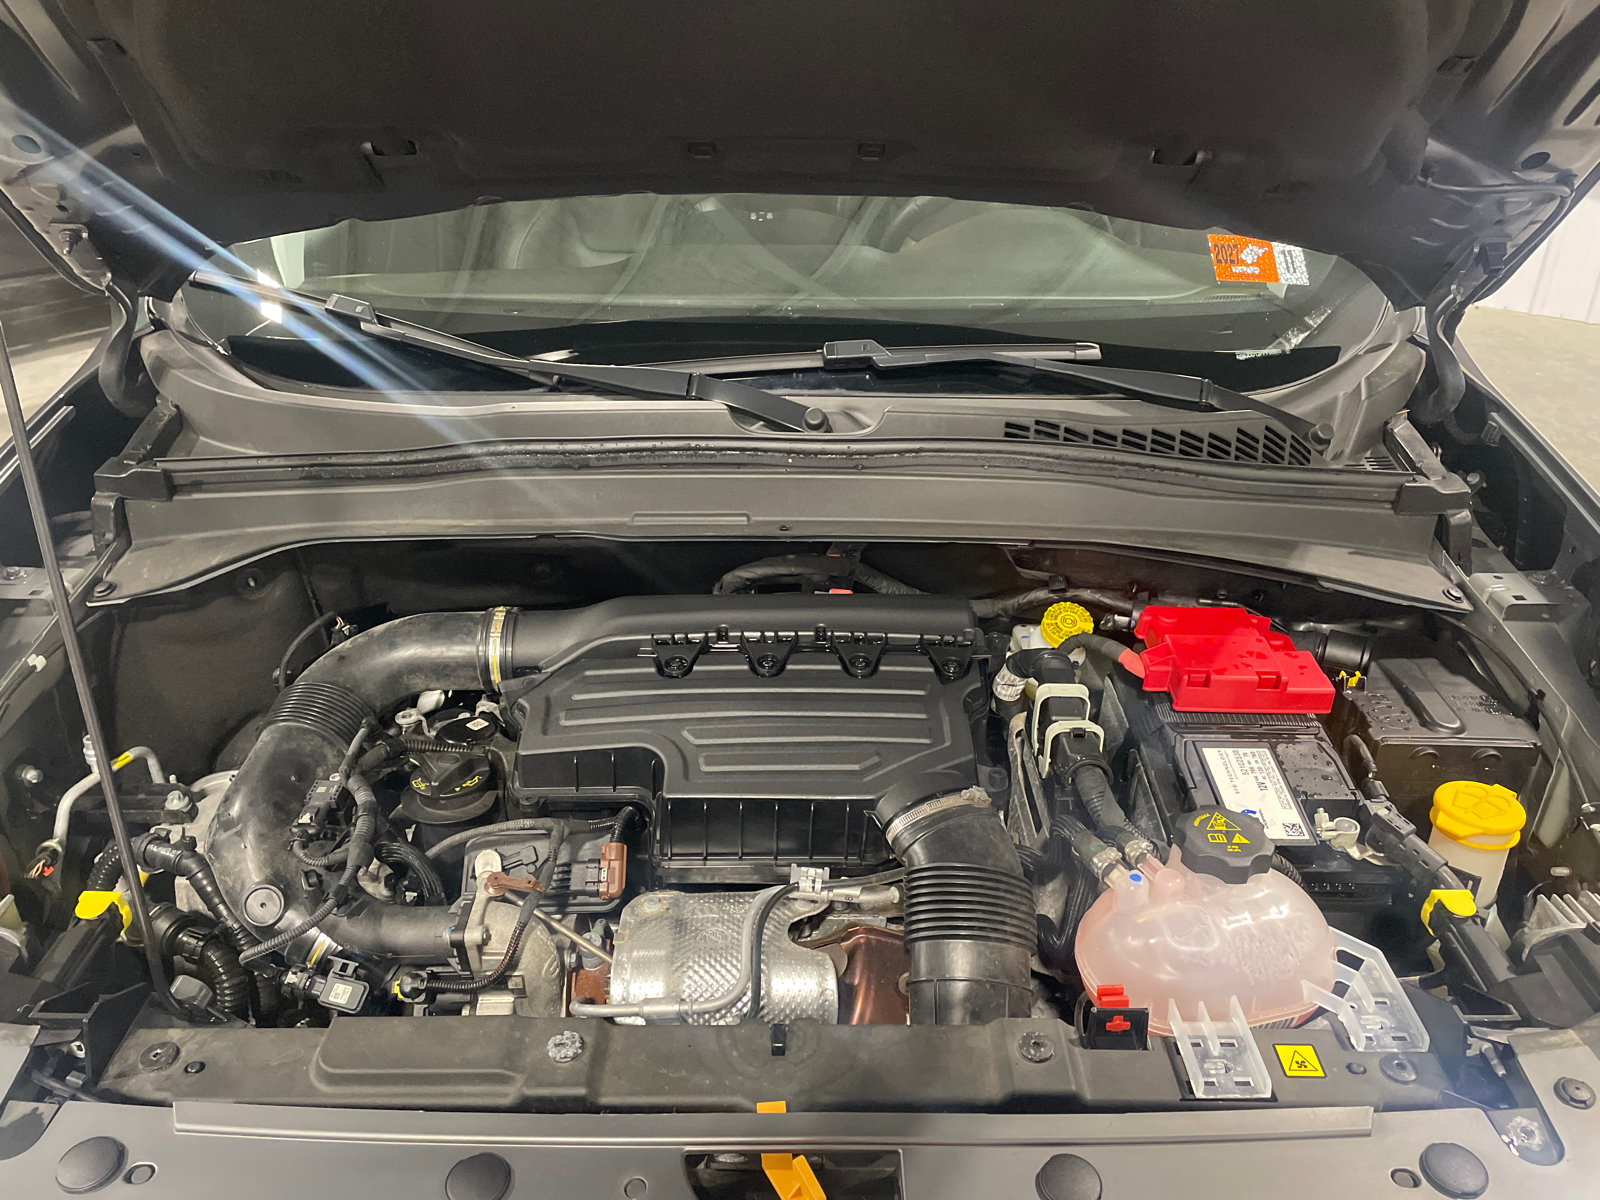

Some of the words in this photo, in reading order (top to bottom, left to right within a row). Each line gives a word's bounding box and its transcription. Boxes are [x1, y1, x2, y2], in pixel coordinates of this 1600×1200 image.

[1213, 243, 1239, 264] 2027
[1280, 249, 1297, 273] 11
[1217, 749, 1234, 782] TECHNOLOGY
